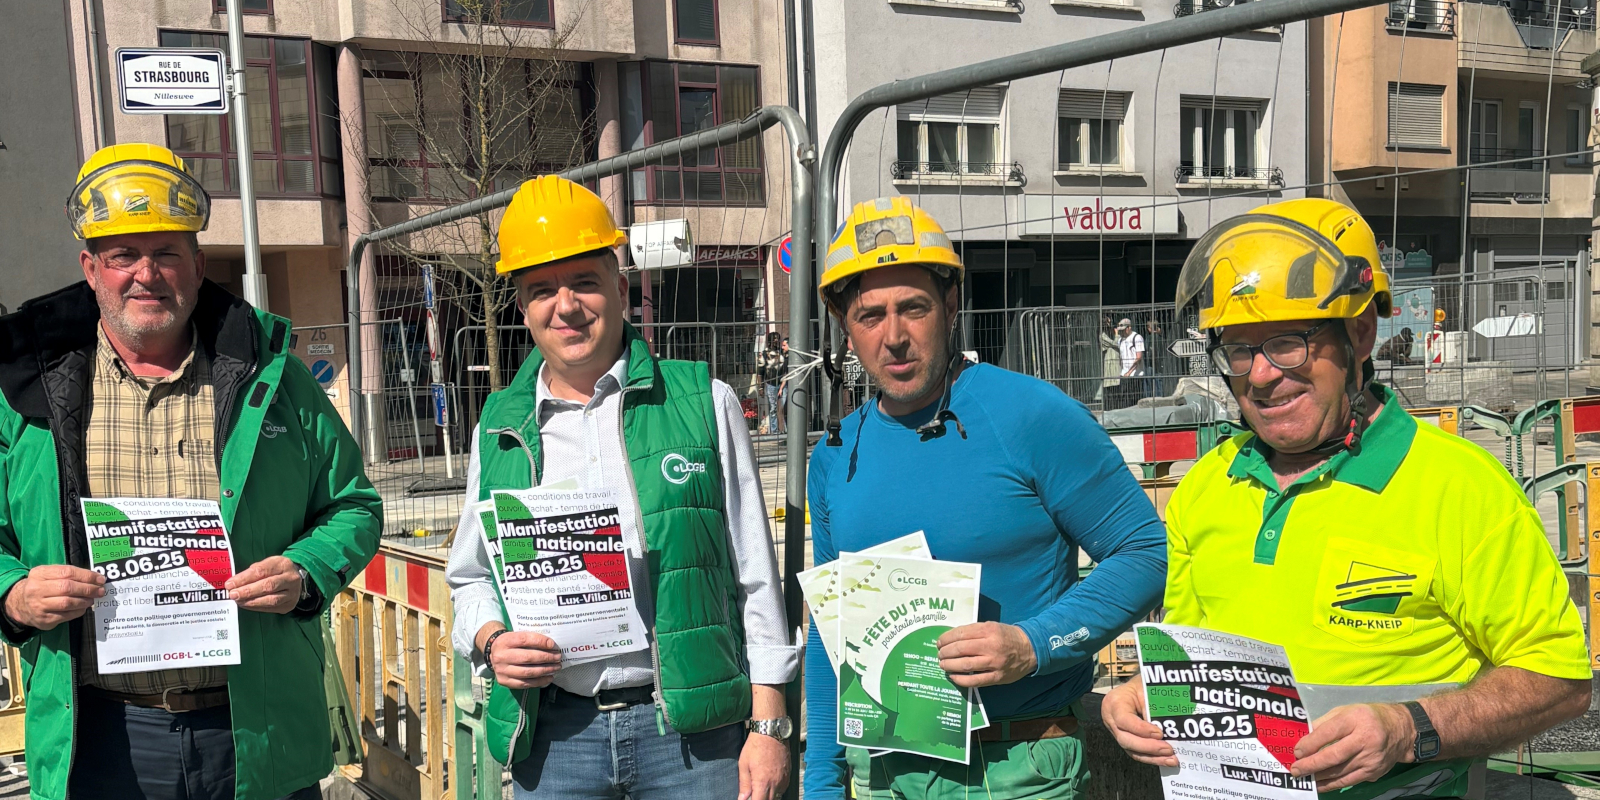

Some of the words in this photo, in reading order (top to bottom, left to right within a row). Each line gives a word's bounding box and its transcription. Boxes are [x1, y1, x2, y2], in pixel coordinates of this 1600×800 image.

[158, 61, 171, 69] RUE
[173, 61, 181, 69] DE
[134, 70, 209, 83] STRASBOURG
[1063, 197, 1142, 231] valora
[699, 250, 758, 260] AFFAIRES
[679, 462, 706, 472] LCGB
[88, 517, 222, 539] Manifestation
[499, 514, 620, 538] Manifestation
[133, 534, 228, 549] nationale
[536, 536, 624, 552] nationale
[505, 555, 583, 580] 28.06.25
[104, 586, 139, 596] ystème
[155, 581, 181, 591] santé
[902, 576, 928, 586] LCGB
[156, 591, 209, 605] Lux-Ville
[558, 592, 608, 605] Lux-Ville
[612, 589, 631, 600] 11h
[862, 616, 891, 647] FÊTE
[888, 603, 908, 622] DU
[909, 598, 926, 612] 1ER
[928, 597, 955, 612] MAI
[1329, 615, 1403, 630] KARP-KNEIP
[606, 638, 633, 648] LCGB
[1138, 627, 1174, 636] alaires
[1181, 631, 1233, 645] conditions
[1234, 638, 1247, 648] de
[1248, 641, 1279, 654] travail
[202, 648, 232, 658] LCGB
[1178, 644, 1216, 656] d'achat
[1223, 649, 1256, 662] temps
[1143, 663, 1296, 687] Manifestation
[1150, 687, 1181, 698] droits
[1194, 686, 1307, 720] nationale
[1280, 727, 1295, 738] de
[1267, 743, 1295, 755] pens
[1173, 747, 1204, 759] stème
[1205, 752, 1218, 761] de
[1220, 755, 1249, 765] santé
[1257, 757, 1291, 770] logem
[1188, 762, 1199, 771] et
[1223, 766, 1282, 787] Lux-Ville
[1170, 780, 1194, 790] Contre
